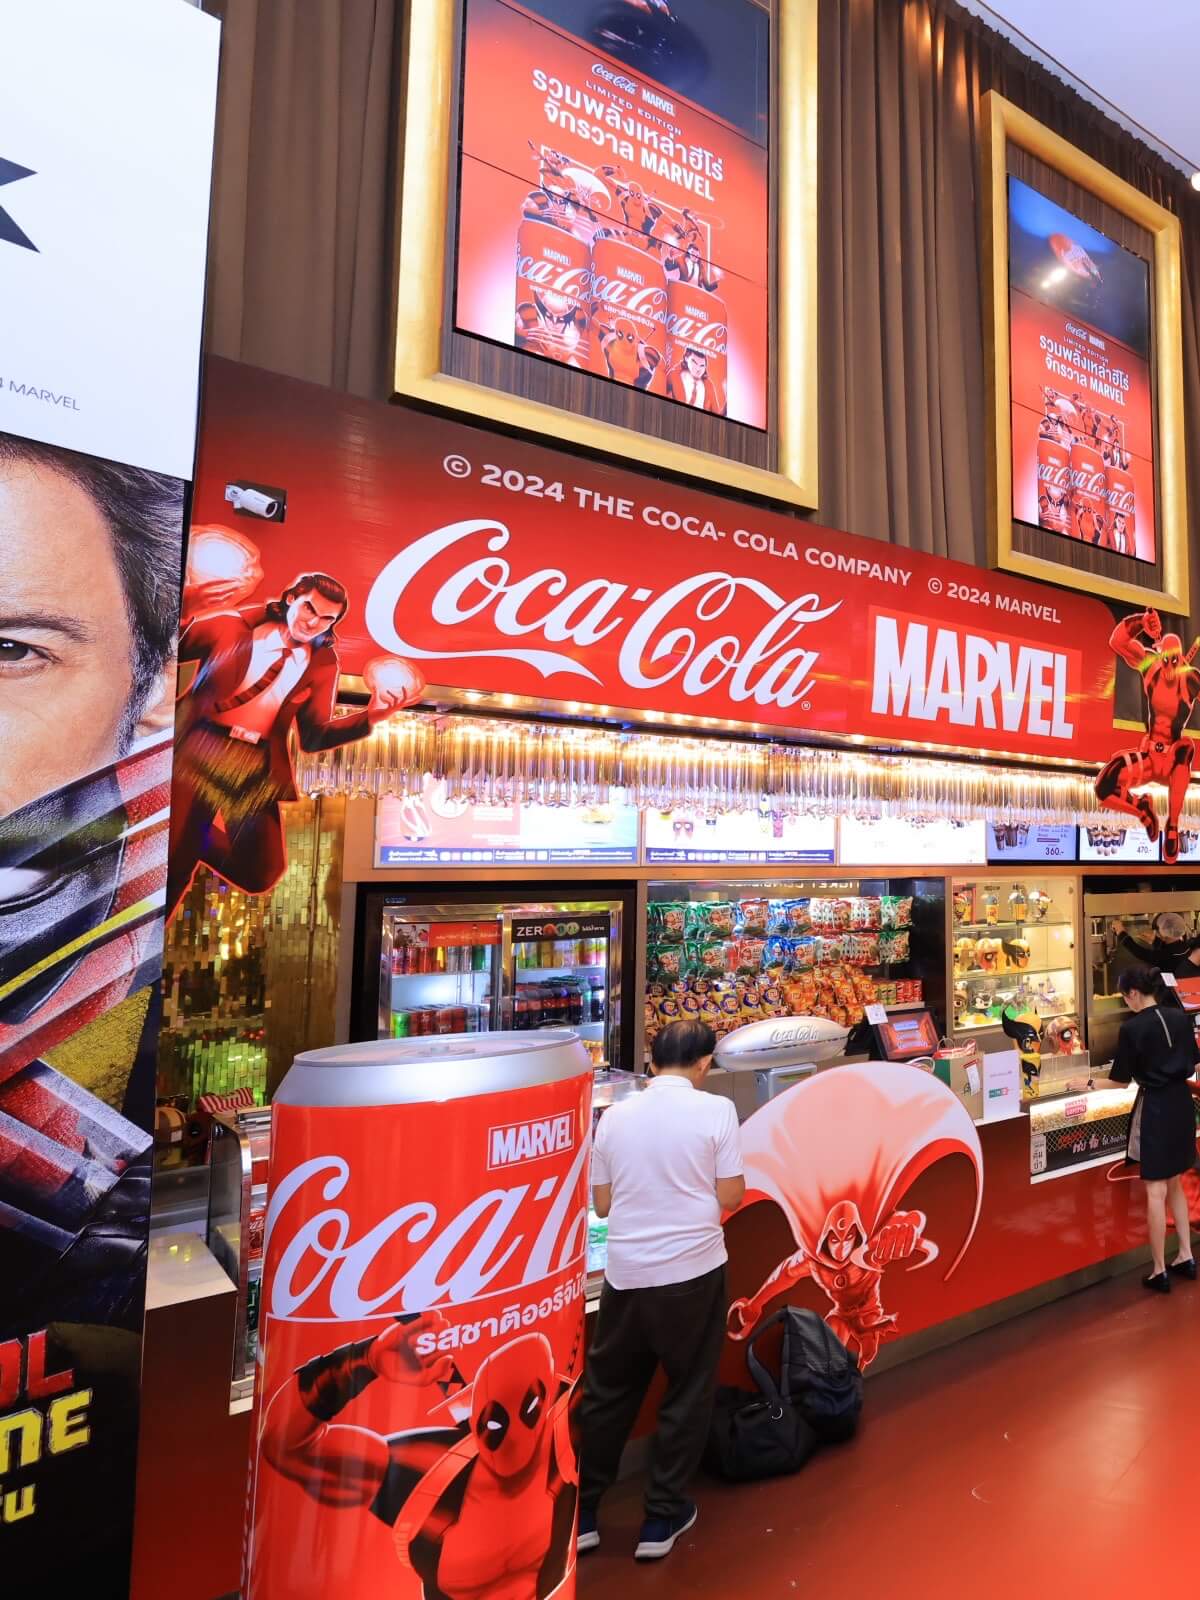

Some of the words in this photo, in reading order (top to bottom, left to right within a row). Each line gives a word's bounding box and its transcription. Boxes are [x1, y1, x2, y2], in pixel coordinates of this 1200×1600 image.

[585, 79, 634, 110] LIMITED
[637, 108, 682, 136] EDITION
[592, 63, 639, 95] Coca-Cola
[642, 88, 676, 117] MARVEL
[532, 68, 724, 182] รวมพลังเหล่าฮีโร่
[543, 97, 635, 161] จักรวาล
[640, 149, 715, 202] MARVEL
[543, 247, 570, 266] MARVEL
[616, 266, 644, 285] MARVEL
[9, 380, 81, 411] MARVEL
[1045, 353, 1088, 387] จักรวาล
[1089, 377, 1126, 406] MARVEL
[480, 463, 566, 504] 2024
[573, 486, 635, 521] THE
[804, 547, 913, 588] COMPANY
[946, 582, 992, 608] 2024
[994, 594, 1062, 624] MARVEL
[366, 518, 844, 709] Coca-Cola
[869, 614, 1074, 740] MARVEL
[491, 1114, 574, 1168] MARVEL
